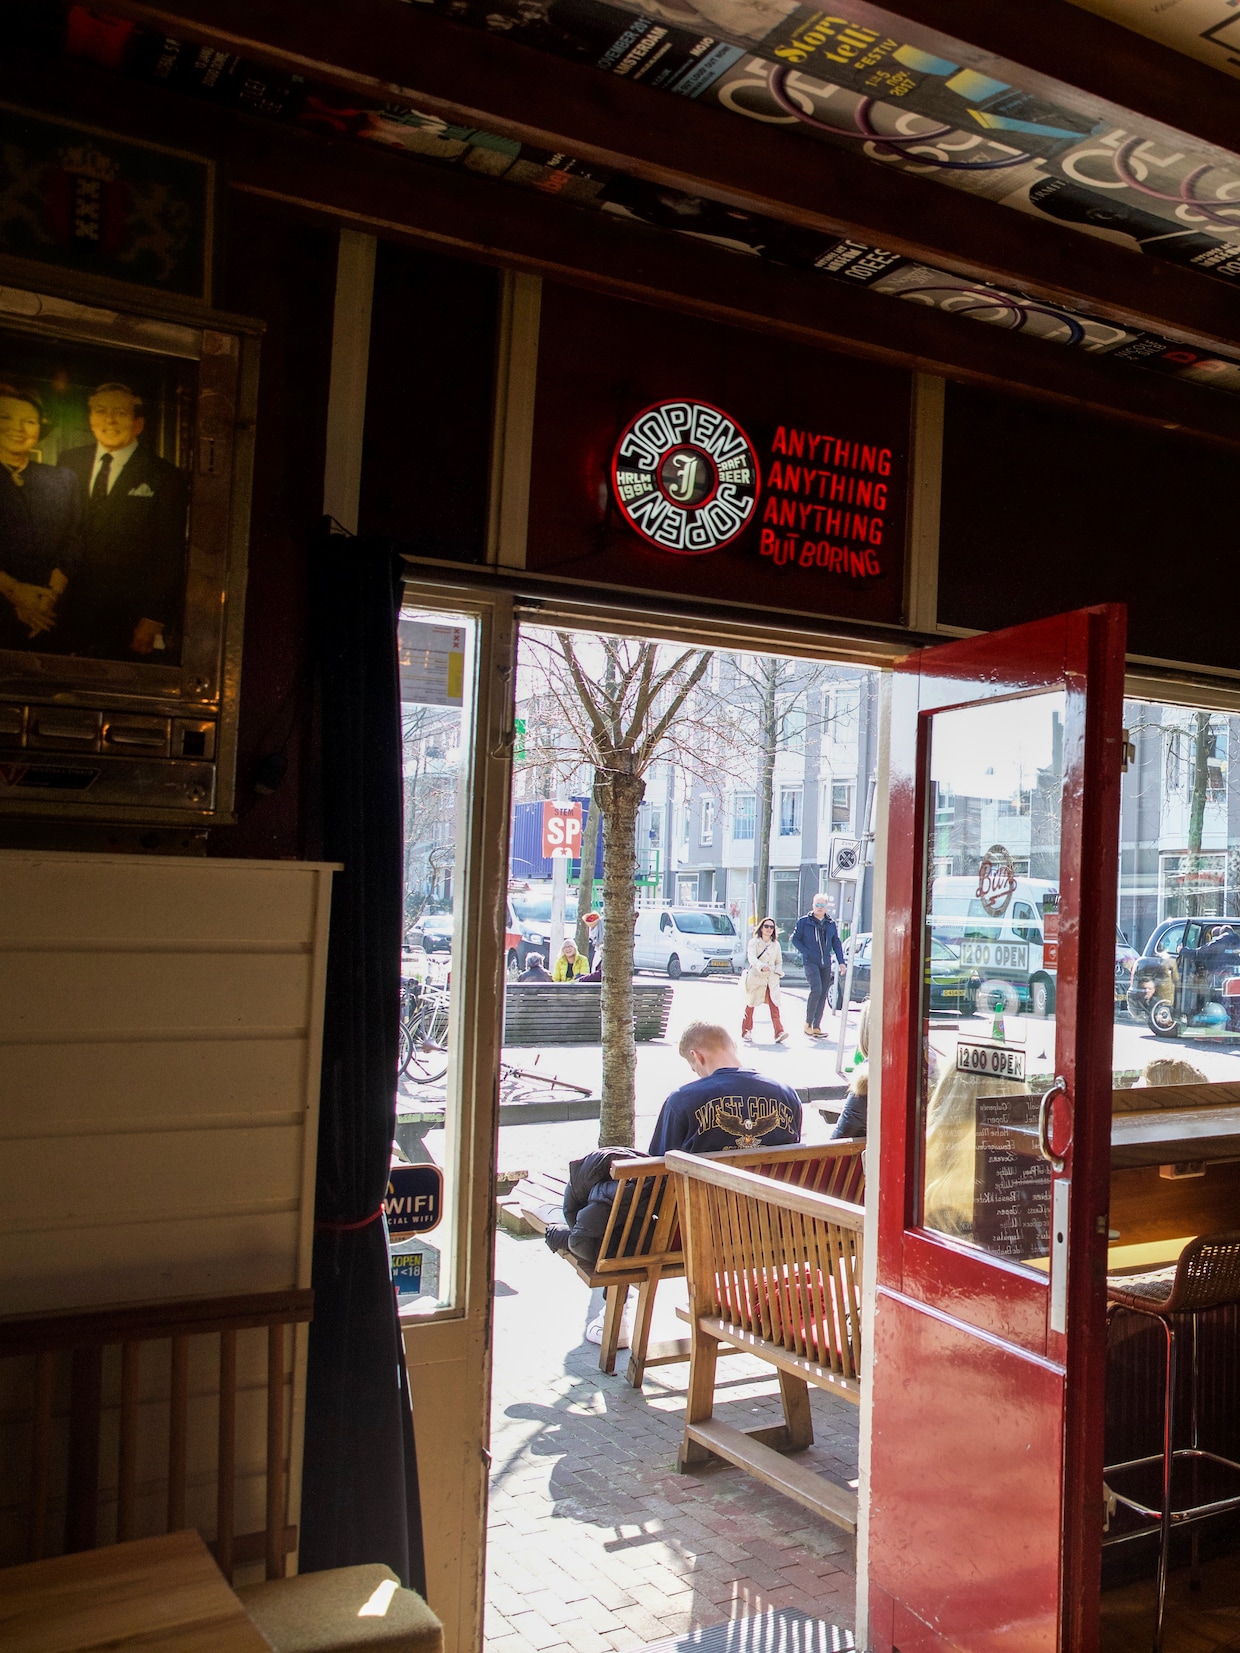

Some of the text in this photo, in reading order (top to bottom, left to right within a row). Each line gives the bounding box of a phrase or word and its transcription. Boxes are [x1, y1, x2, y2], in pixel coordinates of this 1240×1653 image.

[612, 25, 669, 75] AMSTERDAM
[690, 37, 715, 57] MOJO
[620, 402, 749, 472] JOPEN
[771, 425, 893, 477] ANYTHING
[616, 470, 652, 485] HRLM
[766, 460, 889, 511] ANYTHING
[618, 483, 654, 502] 1994
[626, 482, 755, 551] JOPEN
[762, 495, 884, 546] ANYTHING
[759, 527, 882, 578] BUT BORING
[554, 808, 574, 817] STEM
[547, 816, 581, 845] SP
[995, 945, 1026, 969] OPEN
[990, 1051, 1024, 1078] OPEN
[694, 1095, 795, 1136] WEST COAST
[384, 1194, 434, 1215] WIFI
[411, 1214, 433, 1223] WIFI
